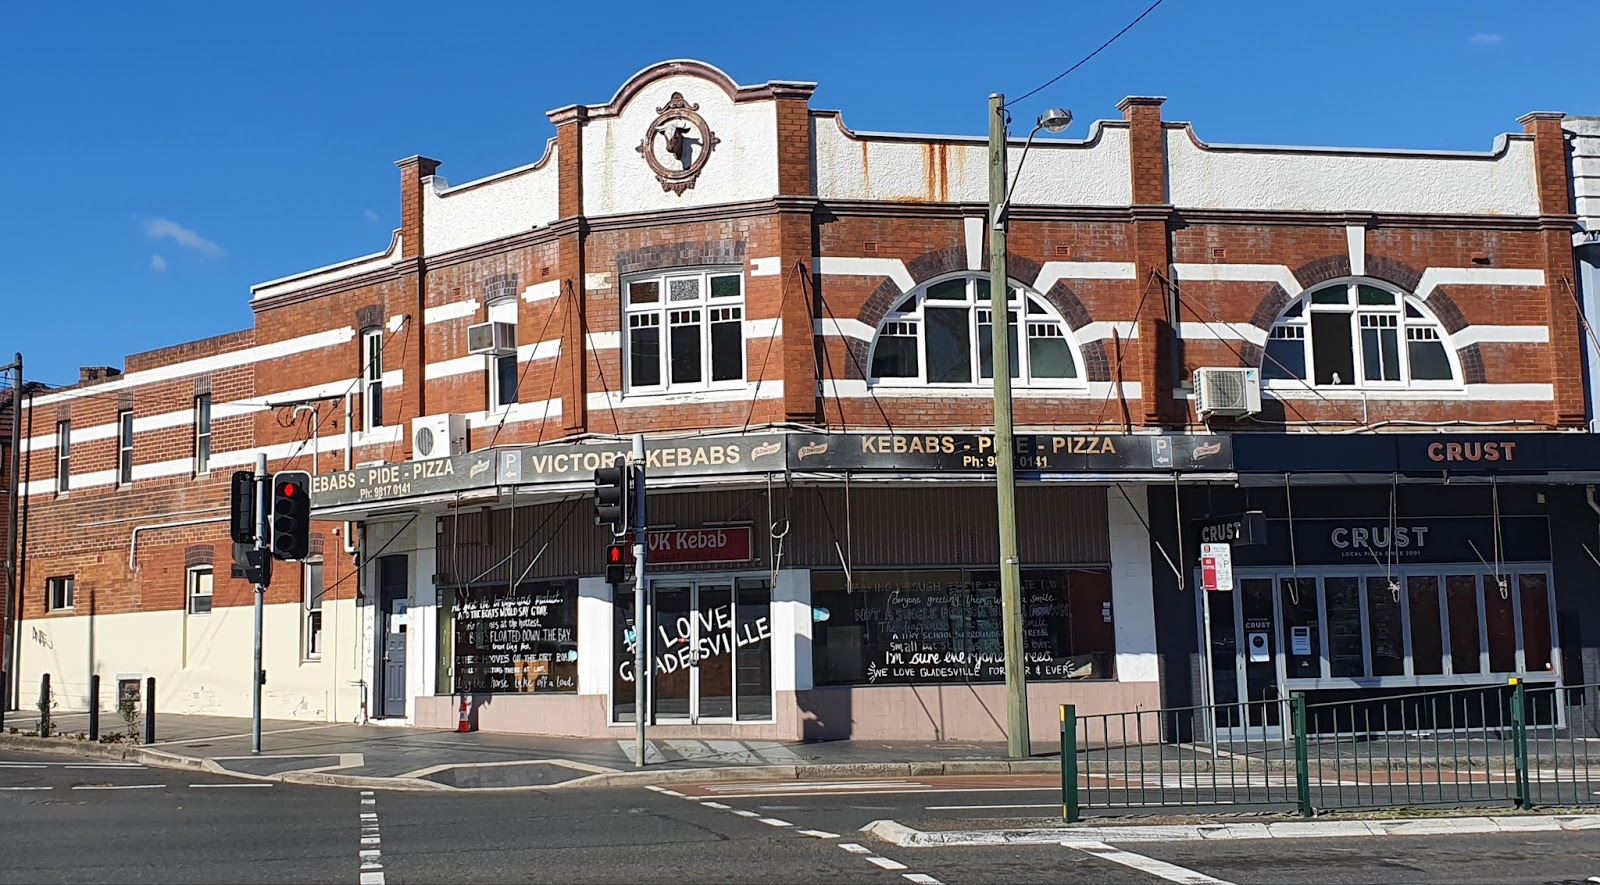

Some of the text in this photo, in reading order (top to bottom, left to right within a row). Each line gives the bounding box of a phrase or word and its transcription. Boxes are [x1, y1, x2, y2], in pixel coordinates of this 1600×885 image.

[861, 435, 955, 454] KEBABS
[978, 436, 1029, 454] PIE
[1052, 436, 1117, 455] PIZZA
[1427, 442, 1516, 461] CRUST
[532, 445, 740, 474] VICTOR KEBABS
[963, 455, 984, 468] Ph:
[1019, 456, 1048, 468] 0141
[313, 472, 356, 493] EBABS
[368, 466, 400, 486] PIDE
[413, 459, 455, 480] PIZZA
[360, 483, 411, 499] Ph: 9817 0141
[676, 530, 727, 549] Kebab
[1202, 522, 1241, 542] CRUST
[1331, 527, 1428, 548] CRUST
[1245, 621, 1271, 629] CRUST
[489, 629, 521, 643] FLOATED
[542, 628, 557, 641] THE
[619, 616, 772, 682] GADESVILLE
[893, 668, 915, 677] LOVE
[920, 667, 981, 678] GLADESVILLE
[1045, 665, 1068, 675] EVER
